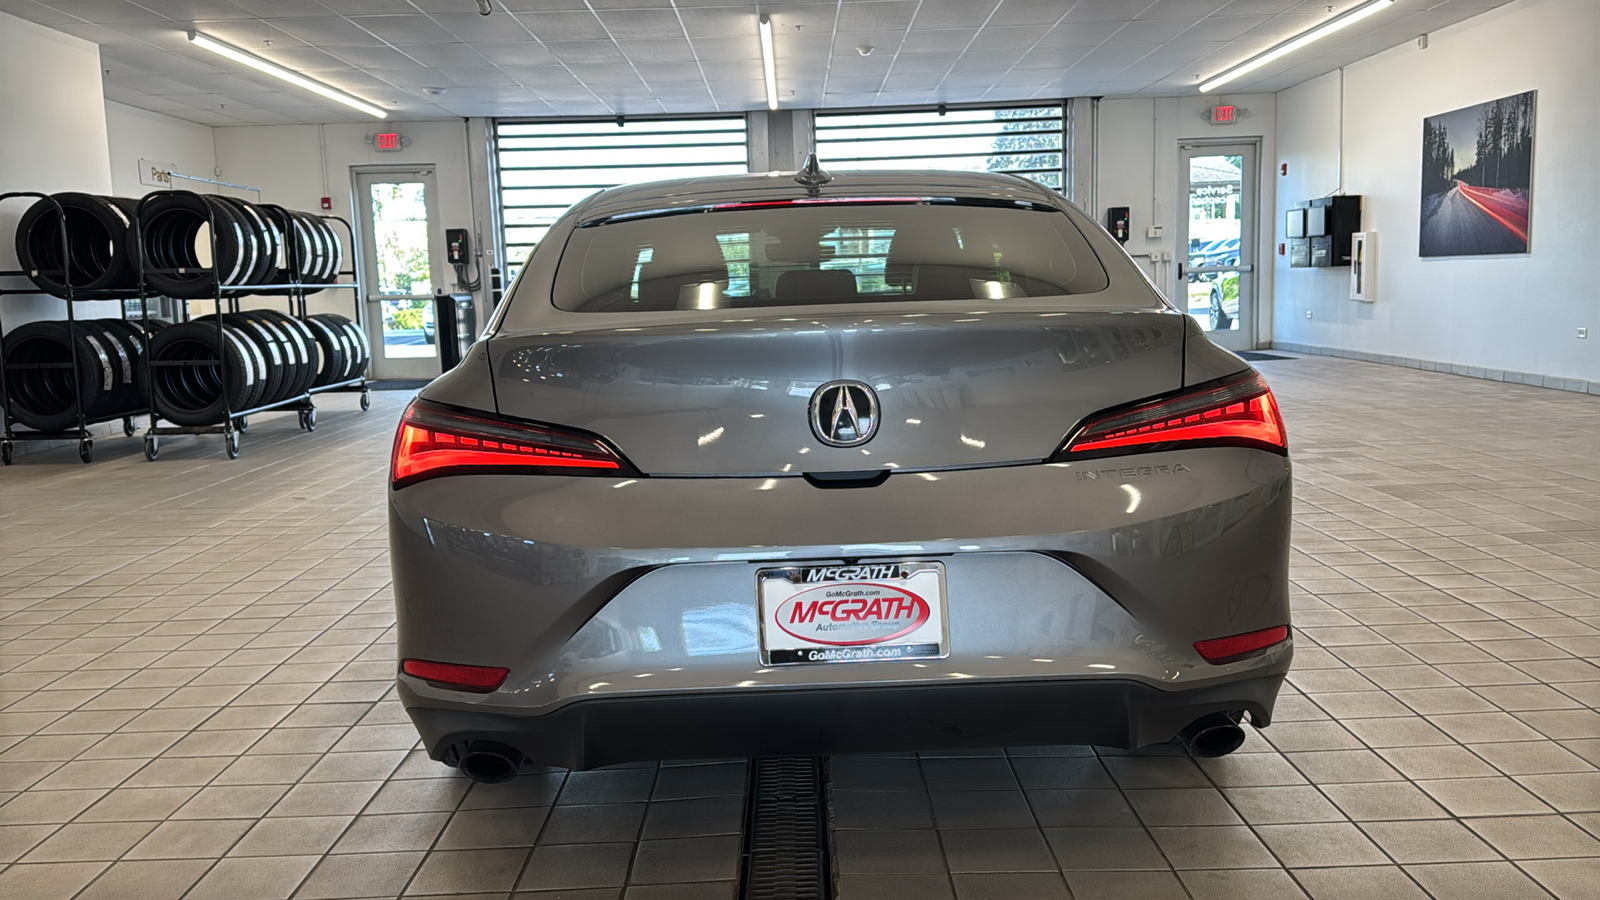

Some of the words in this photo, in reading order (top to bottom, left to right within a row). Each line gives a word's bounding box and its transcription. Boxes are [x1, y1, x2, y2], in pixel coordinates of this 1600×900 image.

[1215, 106, 1234, 121] EXIT
[378, 133, 397, 149] EXIT
[151, 166, 170, 183] Parts
[1076, 463, 1191, 481] INTEGRA
[826, 590, 880, 598] GoMcGrath.com
[870, 620, 900, 631] Group
[808, 647, 901, 662] GoMcGrath.com
